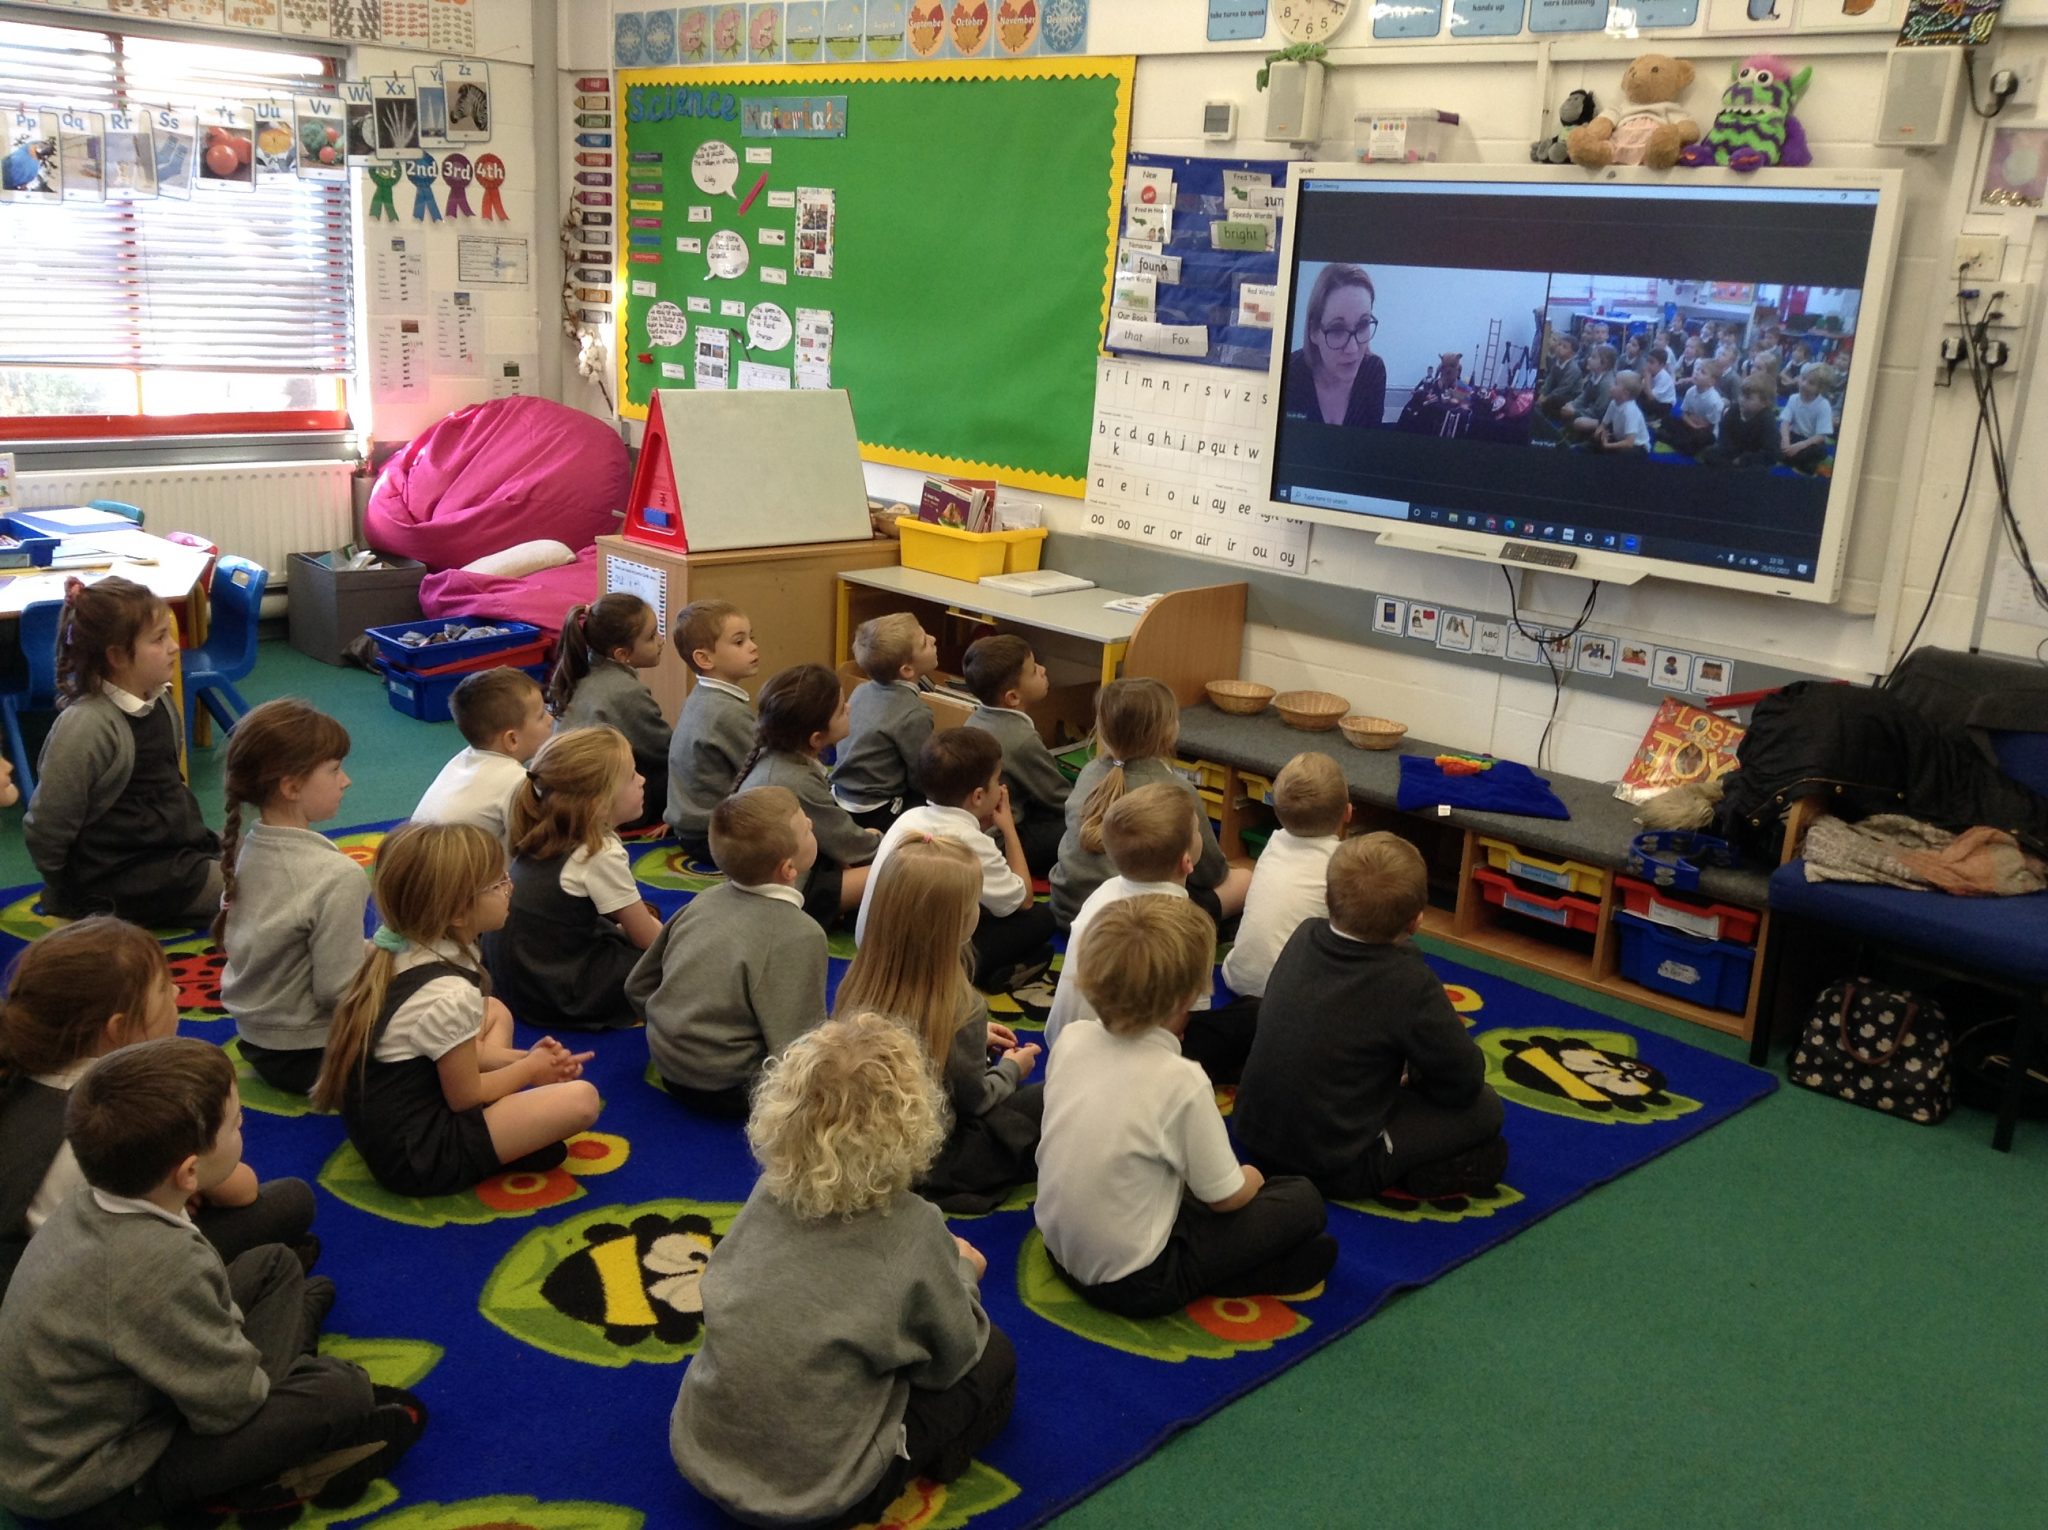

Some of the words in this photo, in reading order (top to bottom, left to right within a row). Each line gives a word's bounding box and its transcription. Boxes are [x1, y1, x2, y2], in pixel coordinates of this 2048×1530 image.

[1248, 9, 1265, 17] speak
[1284, 7, 1292, 18] 8
[1472, 4, 1493, 12] hands
[1495, 4, 1505, 12] up
[909, 18, 944, 30] September
[956, 17, 984, 27] October
[1000, 16, 1036, 25] November
[1046, 15, 1082, 25] December
[1293, 19, 1300, 30] 7
[1320, 17, 1328, 29] 5
[1305, 23, 1313, 34] 6
[458, 64, 472, 76] Zz
[385, 81, 406, 96] Xx
[309, 99, 331, 116] Vv
[629, 84, 739, 123] Science
[257, 103, 280, 119] Uu
[743, 98, 845, 132] Materials
[16, 114, 36, 131] Pp
[62, 114, 85, 131] Qq
[111, 114, 132, 130] Rr
[159, 111, 180, 130] Ss
[406, 160, 439, 178] 2nd
[443, 161, 471, 181] 3rd
[476, 161, 504, 180] 4th
[1143, 171, 1157, 179] New
[1233, 173, 1248, 181] Fred
[1232, 211, 1252, 219] Speedy
[1254, 212, 1273, 220] Words
[1224, 225, 1258, 245] bright
[1117, 311, 1130, 320] Our
[1132, 312, 1148, 322] Book
[1124, 330, 1143, 343] that
[1172, 333, 1190, 345] Fox
[1105, 369, 1112, 382] f
[1124, 371, 1129, 385] l
[1141, 376, 1153, 389] m
[1162, 379, 1170, 391] n
[1183, 382, 1190, 393] r
[1205, 385, 1211, 396] s
[1224, 388, 1231, 399] v
[1244, 391, 1251, 402] z
[1099, 420, 1106, 434] b
[1114, 425, 1120, 437] c
[1129, 425, 1137, 440] d
[1147, 433, 1155, 446] g
[1164, 431, 1171, 446] h
[1180, 434, 1187, 451] j
[1113, 442, 1120, 456] k
[1197, 440, 1206, 454] p
[1211, 441, 1226, 457] qu
[1233, 443, 1239, 456] t
[1248, 447, 1259, 459] w
[1097, 477, 1105, 489] a
[1120, 481, 1127, 492] e
[1145, 483, 1150, 497] i
[1167, 490, 1175, 501] o
[1192, 494, 1200, 506] u
[1211, 498, 1227, 515] ay
[1238, 503, 1251, 515] ee
[1091, 513, 1105, 525] oo
[1117, 518, 1131, 531] oo
[1143, 524, 1156, 535] ar
[1170, 529, 1183, 541] or
[1195, 532, 1212, 547] air
[1227, 538, 1237, 551] ir
[1252, 546, 1268, 559] ou
[1279, 551, 1296, 568] oy
[1483, 630, 1499, 639] ABC
[1674, 705, 1747, 747] LOST
[1653, 730, 1739, 784] TOY
